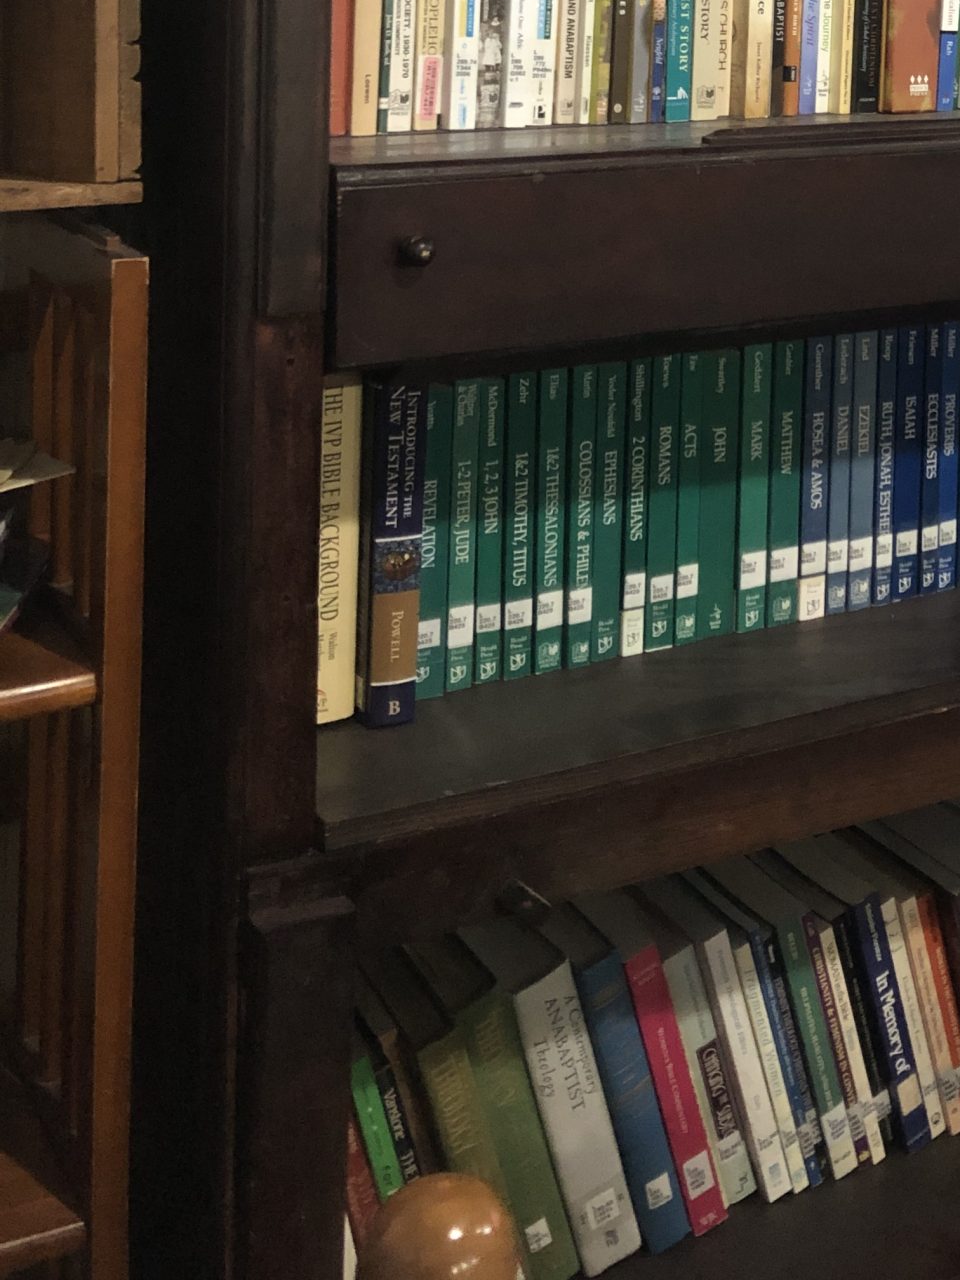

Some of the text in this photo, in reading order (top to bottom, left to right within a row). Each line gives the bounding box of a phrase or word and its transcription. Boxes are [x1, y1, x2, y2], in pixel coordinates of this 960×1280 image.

[564, 18, 575, 78] ANABAPTISM
[678, 25, 690, 73] STORY
[805, 14, 816, 46] Spirit
[820, 13, 832, 52] Journey
[946, 41, 954, 56] Rah
[518, 378, 529, 404] Zehr
[904, 396, 916, 440] ISAIAH
[403, 391, 421, 518] INTRODUCING THE
[657, 426, 672, 485] ROMANS
[684, 424, 696, 458] ACTS
[713, 427, 727, 463] JOHN
[751, 420, 764, 461] MARK
[779, 410, 793, 475] MATTHEW
[836, 406, 849, 455] DANIEL
[858, 404, 870, 456] EZEKIEL
[925, 393, 938, 479] ECCLESIASTES
[943, 393, 956, 456] PROVERBS
[385, 386, 404, 528] NEW TESTAMENT
[602, 450, 617, 525] EPHESIANS
[629, 436, 645, 542] 2 CORINTHIANS
[810, 412, 824, 510] HOSEA & AMOS
[319, 386, 343, 621] THE IVP BIBLE BACKGROUND
[454, 459, 471, 565] 1-2 PETER, JUDE
[511, 452, 528, 587] 1&2 TIMOTHY, TITUS
[543, 448, 560, 586] 1&2 THESSALONIANS
[577, 440, 593, 541] COLOSSIANS &
[421, 480, 437, 568] REVELATION
[389, 610, 405, 663] POWELL
[568, 1007, 596, 1094] Contemporary
[875, 971, 909, 1075] In Memory of
[533, 1040, 557, 1098] Theology
[544, 999, 586, 1112] ANABAPTIST
